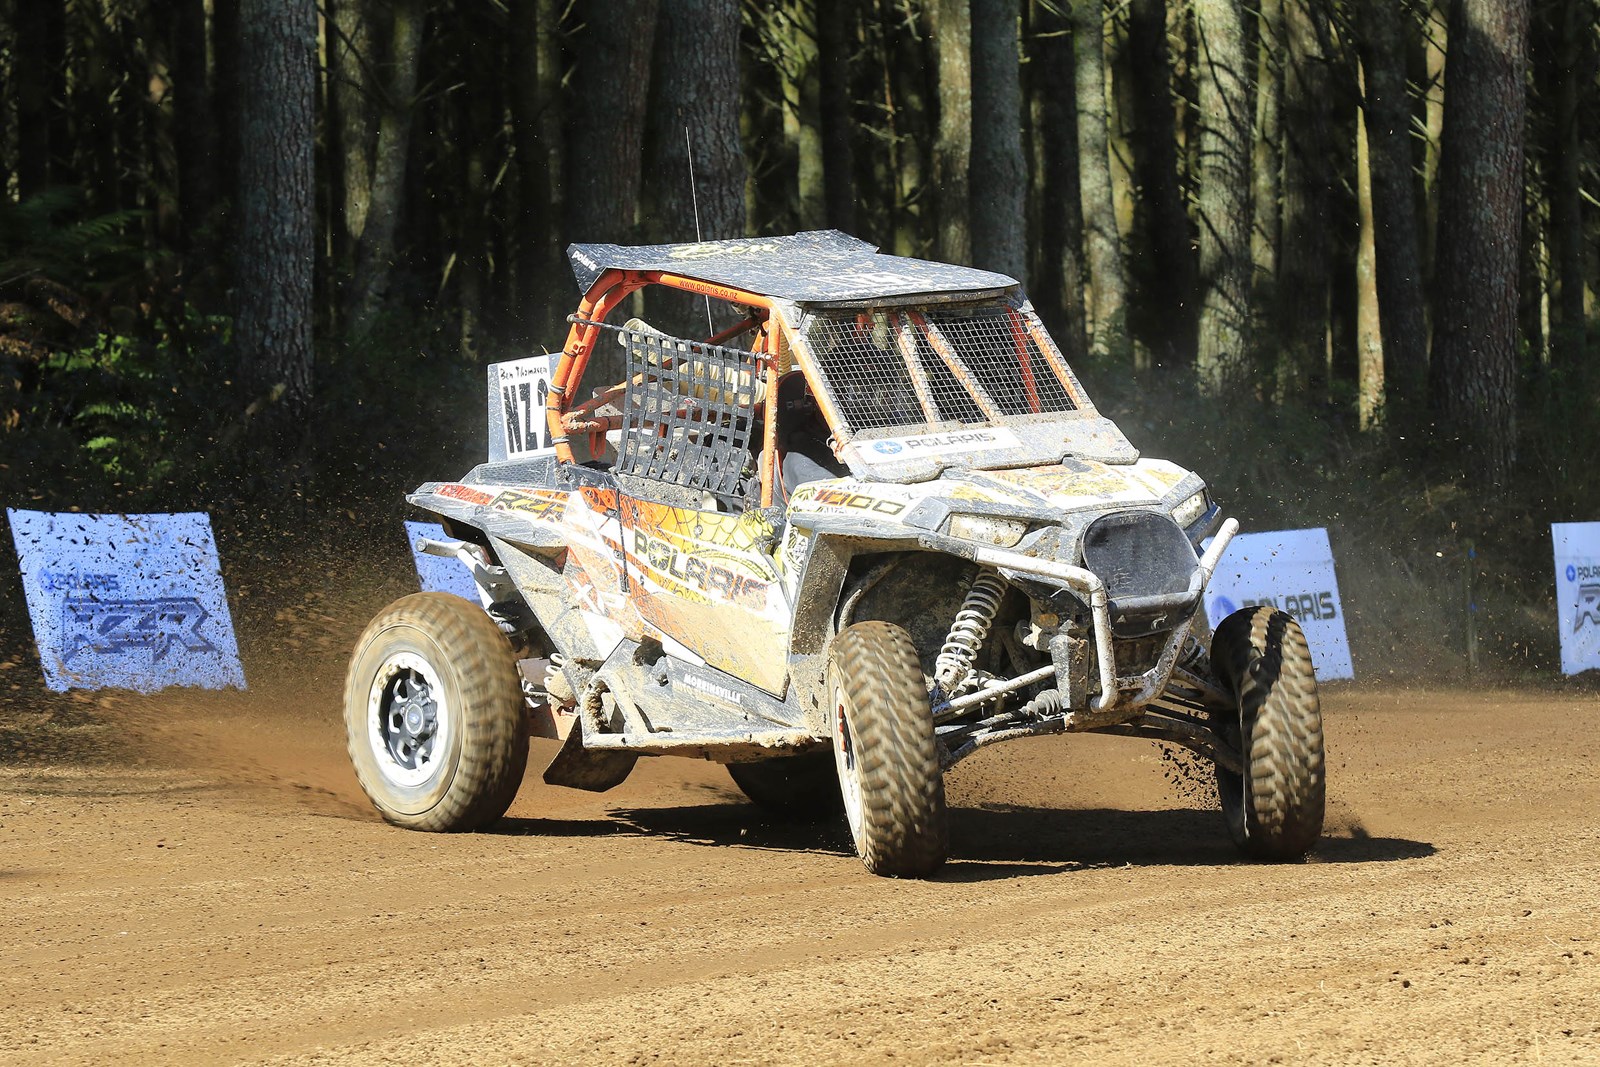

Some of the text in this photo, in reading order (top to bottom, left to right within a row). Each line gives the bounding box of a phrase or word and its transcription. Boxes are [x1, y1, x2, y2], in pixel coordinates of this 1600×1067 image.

[571, 250, 596, 271] polaris
[679, 279, 738, 299] www.polaris.co.nz
[500, 368, 514, 380] Ben
[908, 432, 997, 450] POLARIS
[814, 488, 906, 515] 1000
[634, 527, 769, 612] POLARIS
